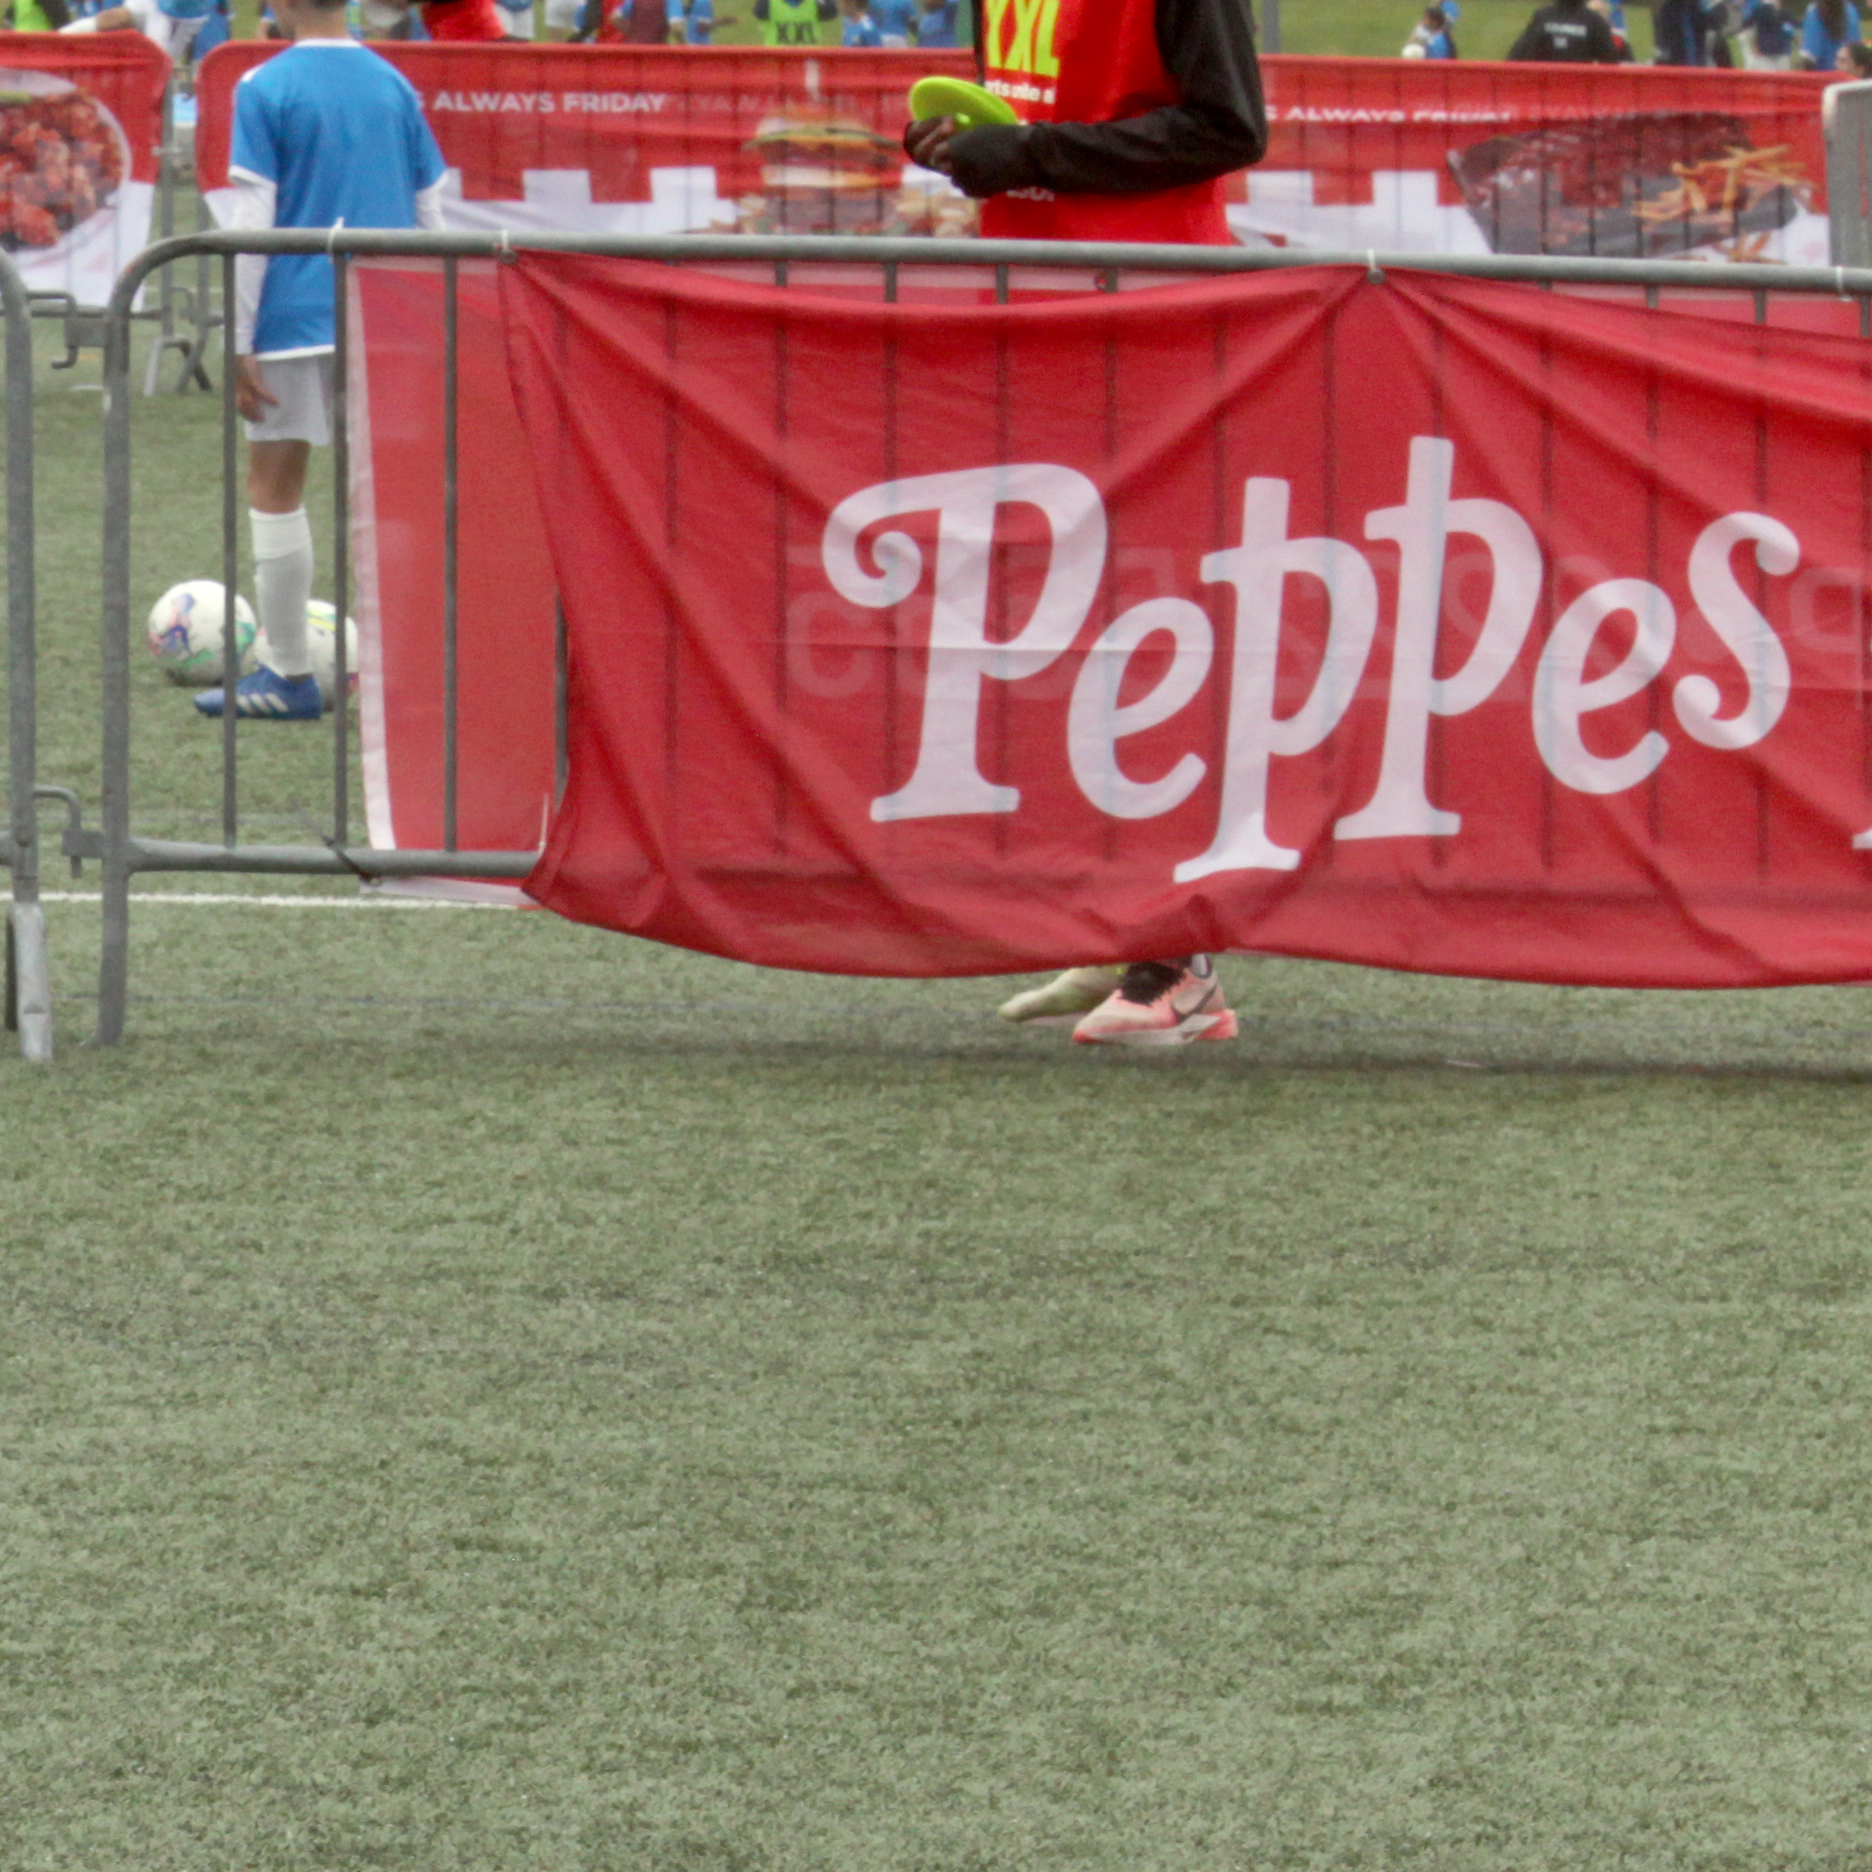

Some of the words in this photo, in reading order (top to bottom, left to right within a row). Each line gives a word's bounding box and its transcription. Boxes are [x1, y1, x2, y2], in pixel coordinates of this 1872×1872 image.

[432, 91, 556, 113] ALWAYS
[563, 92, 667, 113] FRIDAY
[821, 435, 1801, 884] Peppes
